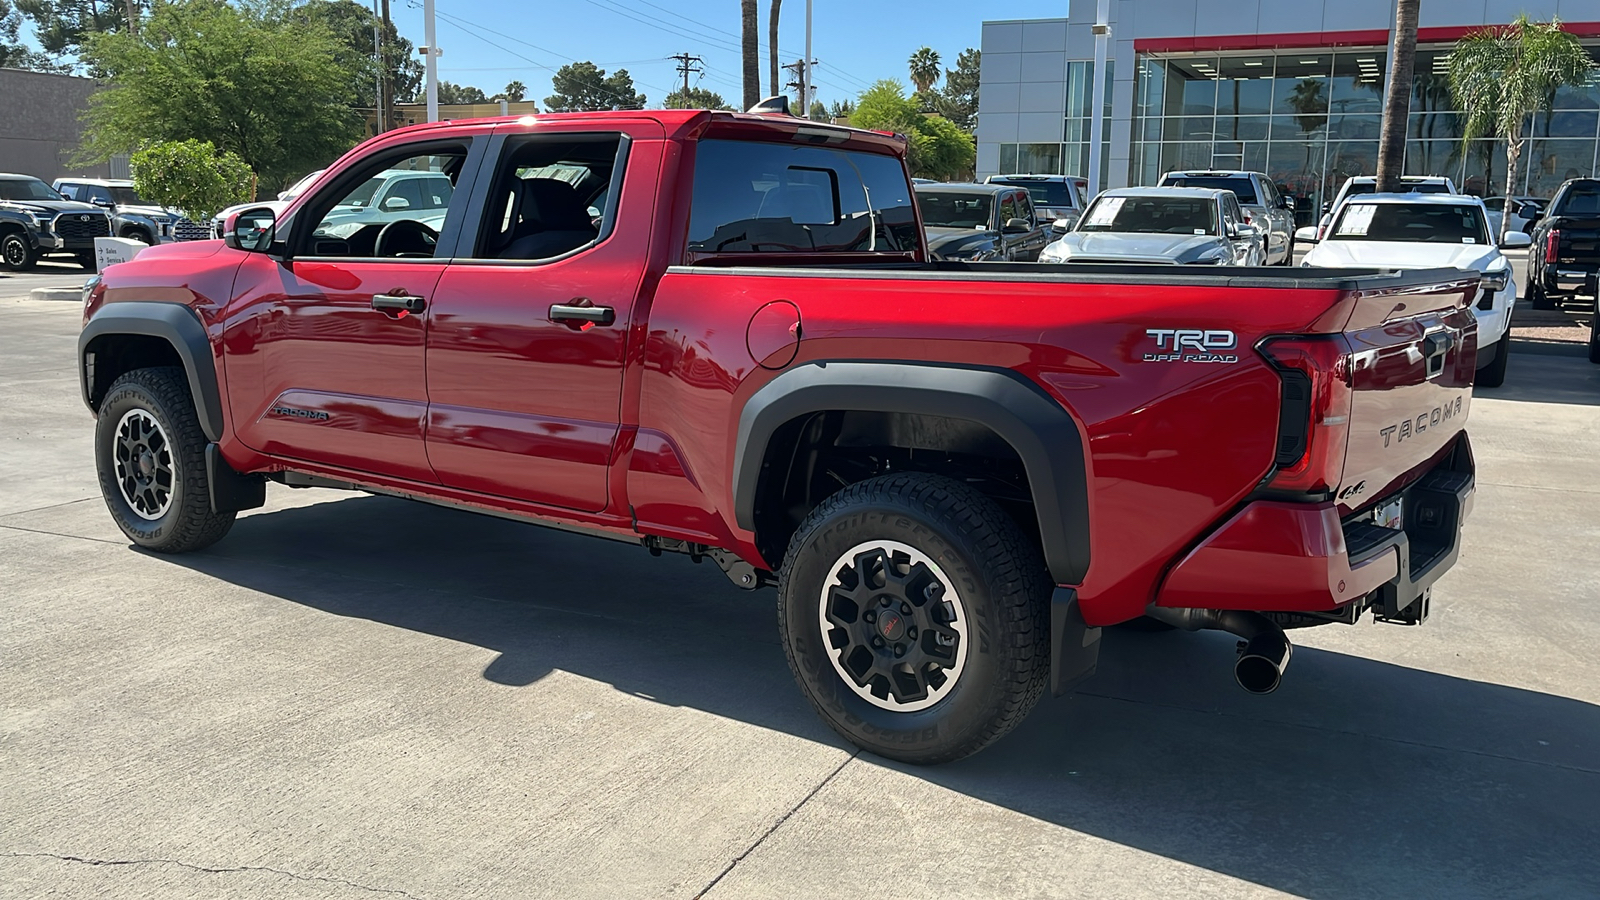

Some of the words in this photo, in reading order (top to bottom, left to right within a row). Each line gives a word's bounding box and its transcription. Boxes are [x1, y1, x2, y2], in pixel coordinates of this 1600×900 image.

[106, 256, 120, 264] Service
[1145, 329, 1238, 352] TRD
[1142, 353, 1181, 362] OFF
[1183, 354, 1238, 363] ROAD
[273, 406, 329, 420] TACOMA
[1379, 395, 1462, 448] TACOMA
